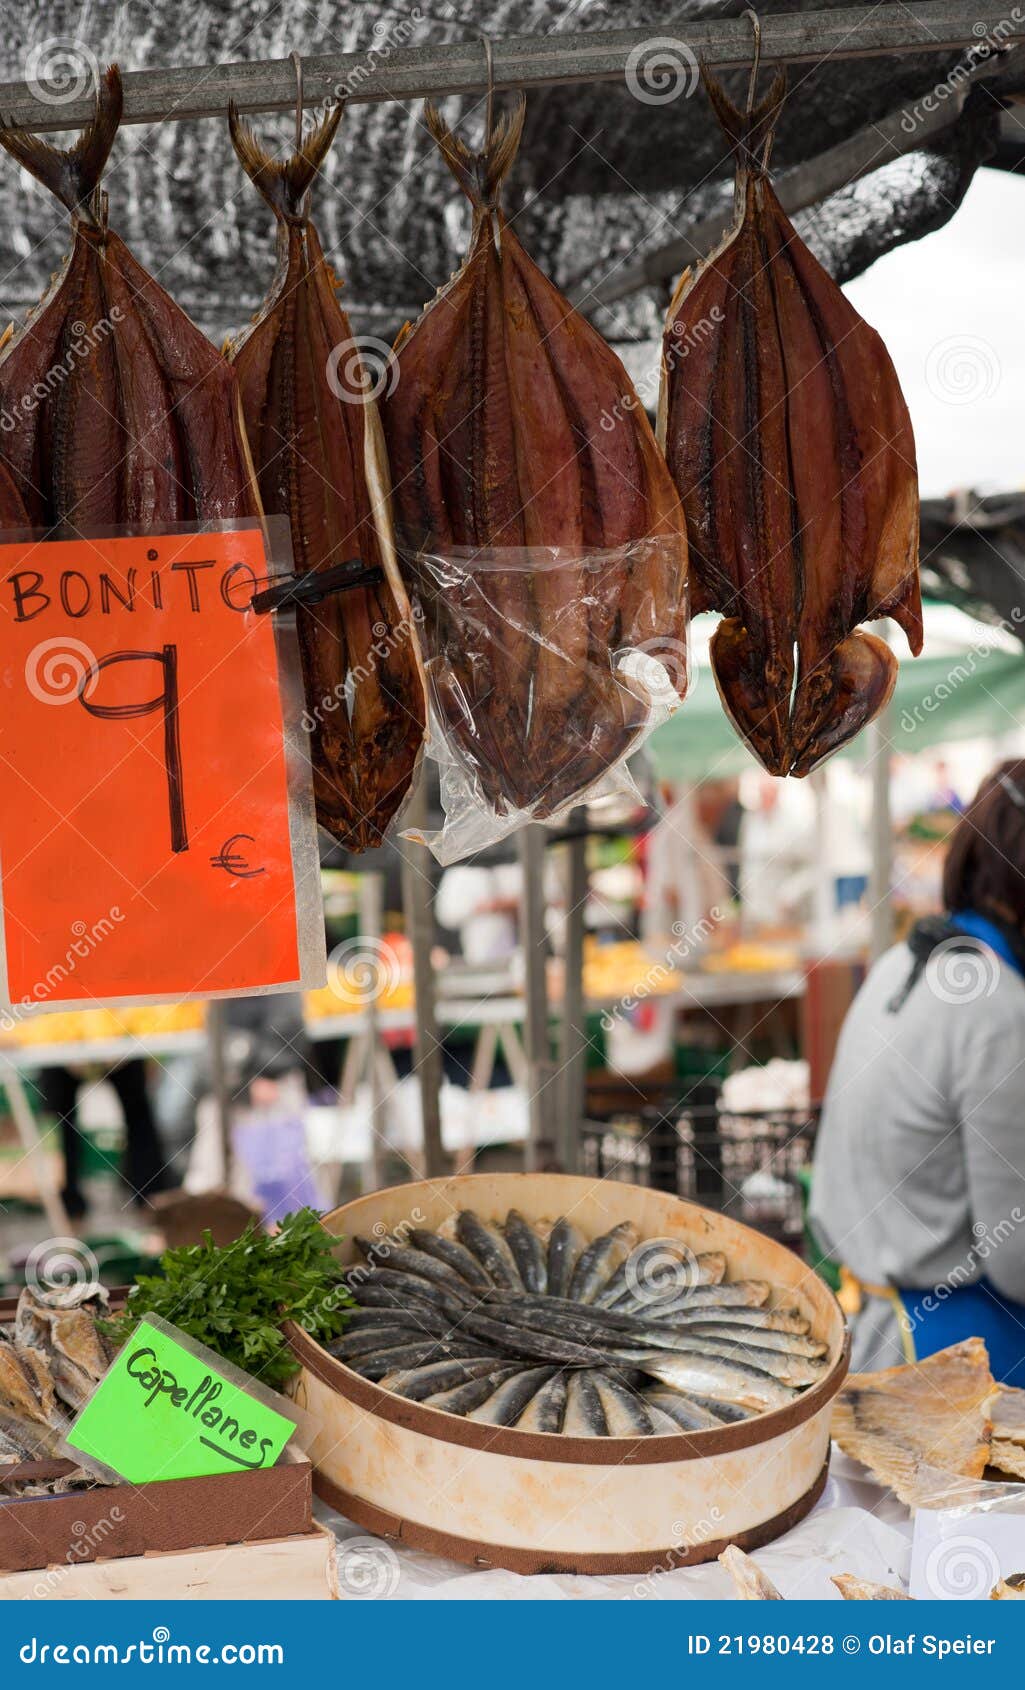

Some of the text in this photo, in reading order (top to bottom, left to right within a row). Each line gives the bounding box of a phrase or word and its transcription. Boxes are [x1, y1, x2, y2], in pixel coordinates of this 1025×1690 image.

[78, 644, 190, 853] 9
[209, 834, 265, 879] €
[126, 1347, 274, 1469] Capellanes
